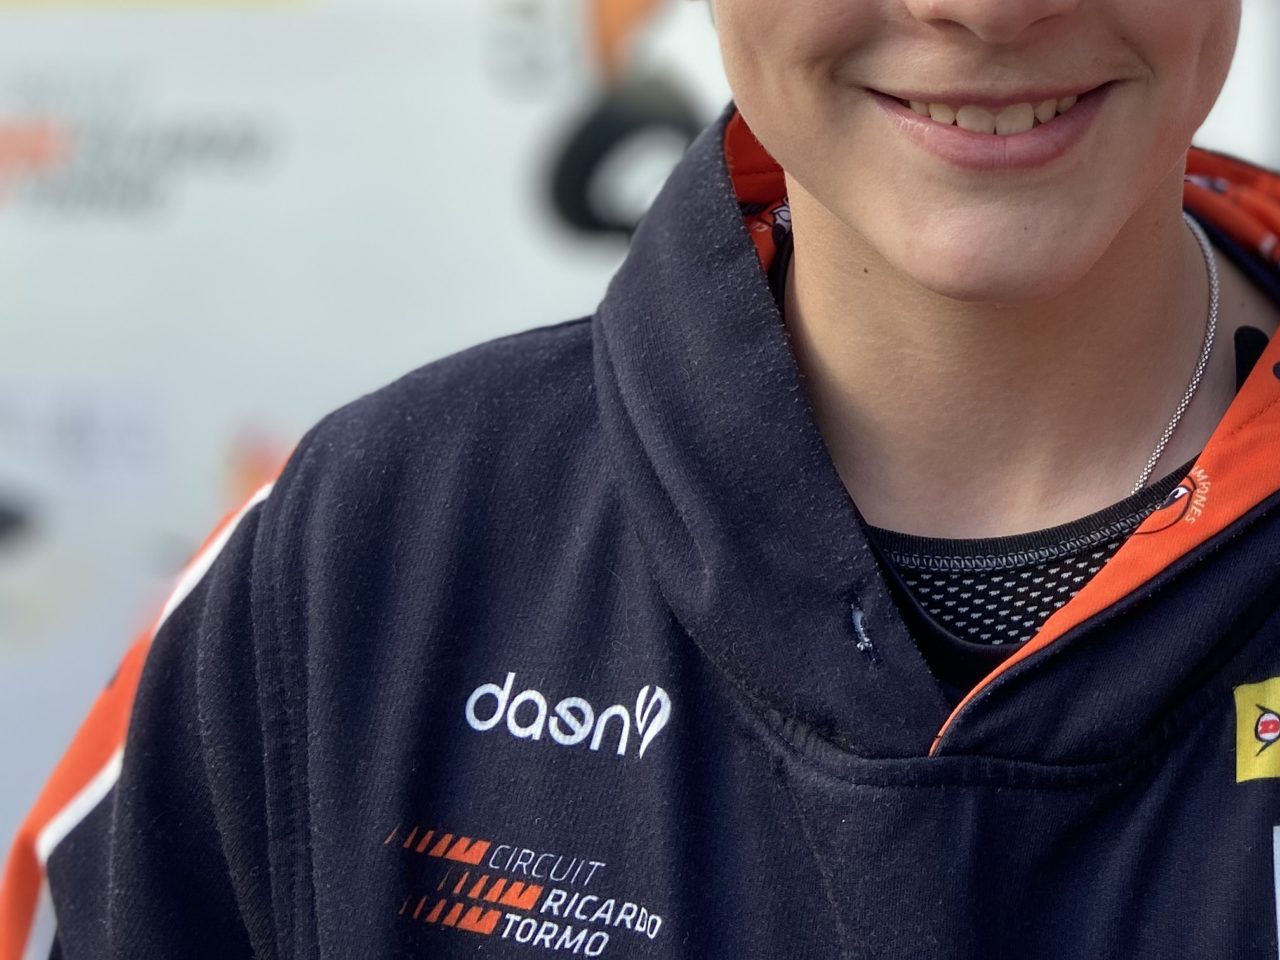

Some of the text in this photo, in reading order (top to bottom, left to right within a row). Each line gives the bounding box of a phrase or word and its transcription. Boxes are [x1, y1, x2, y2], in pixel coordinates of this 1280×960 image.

[488, 844, 606, 887] CIRCUIT
[502, 913, 610, 957] TORMO
[540, 888, 662, 939] RICARDO
